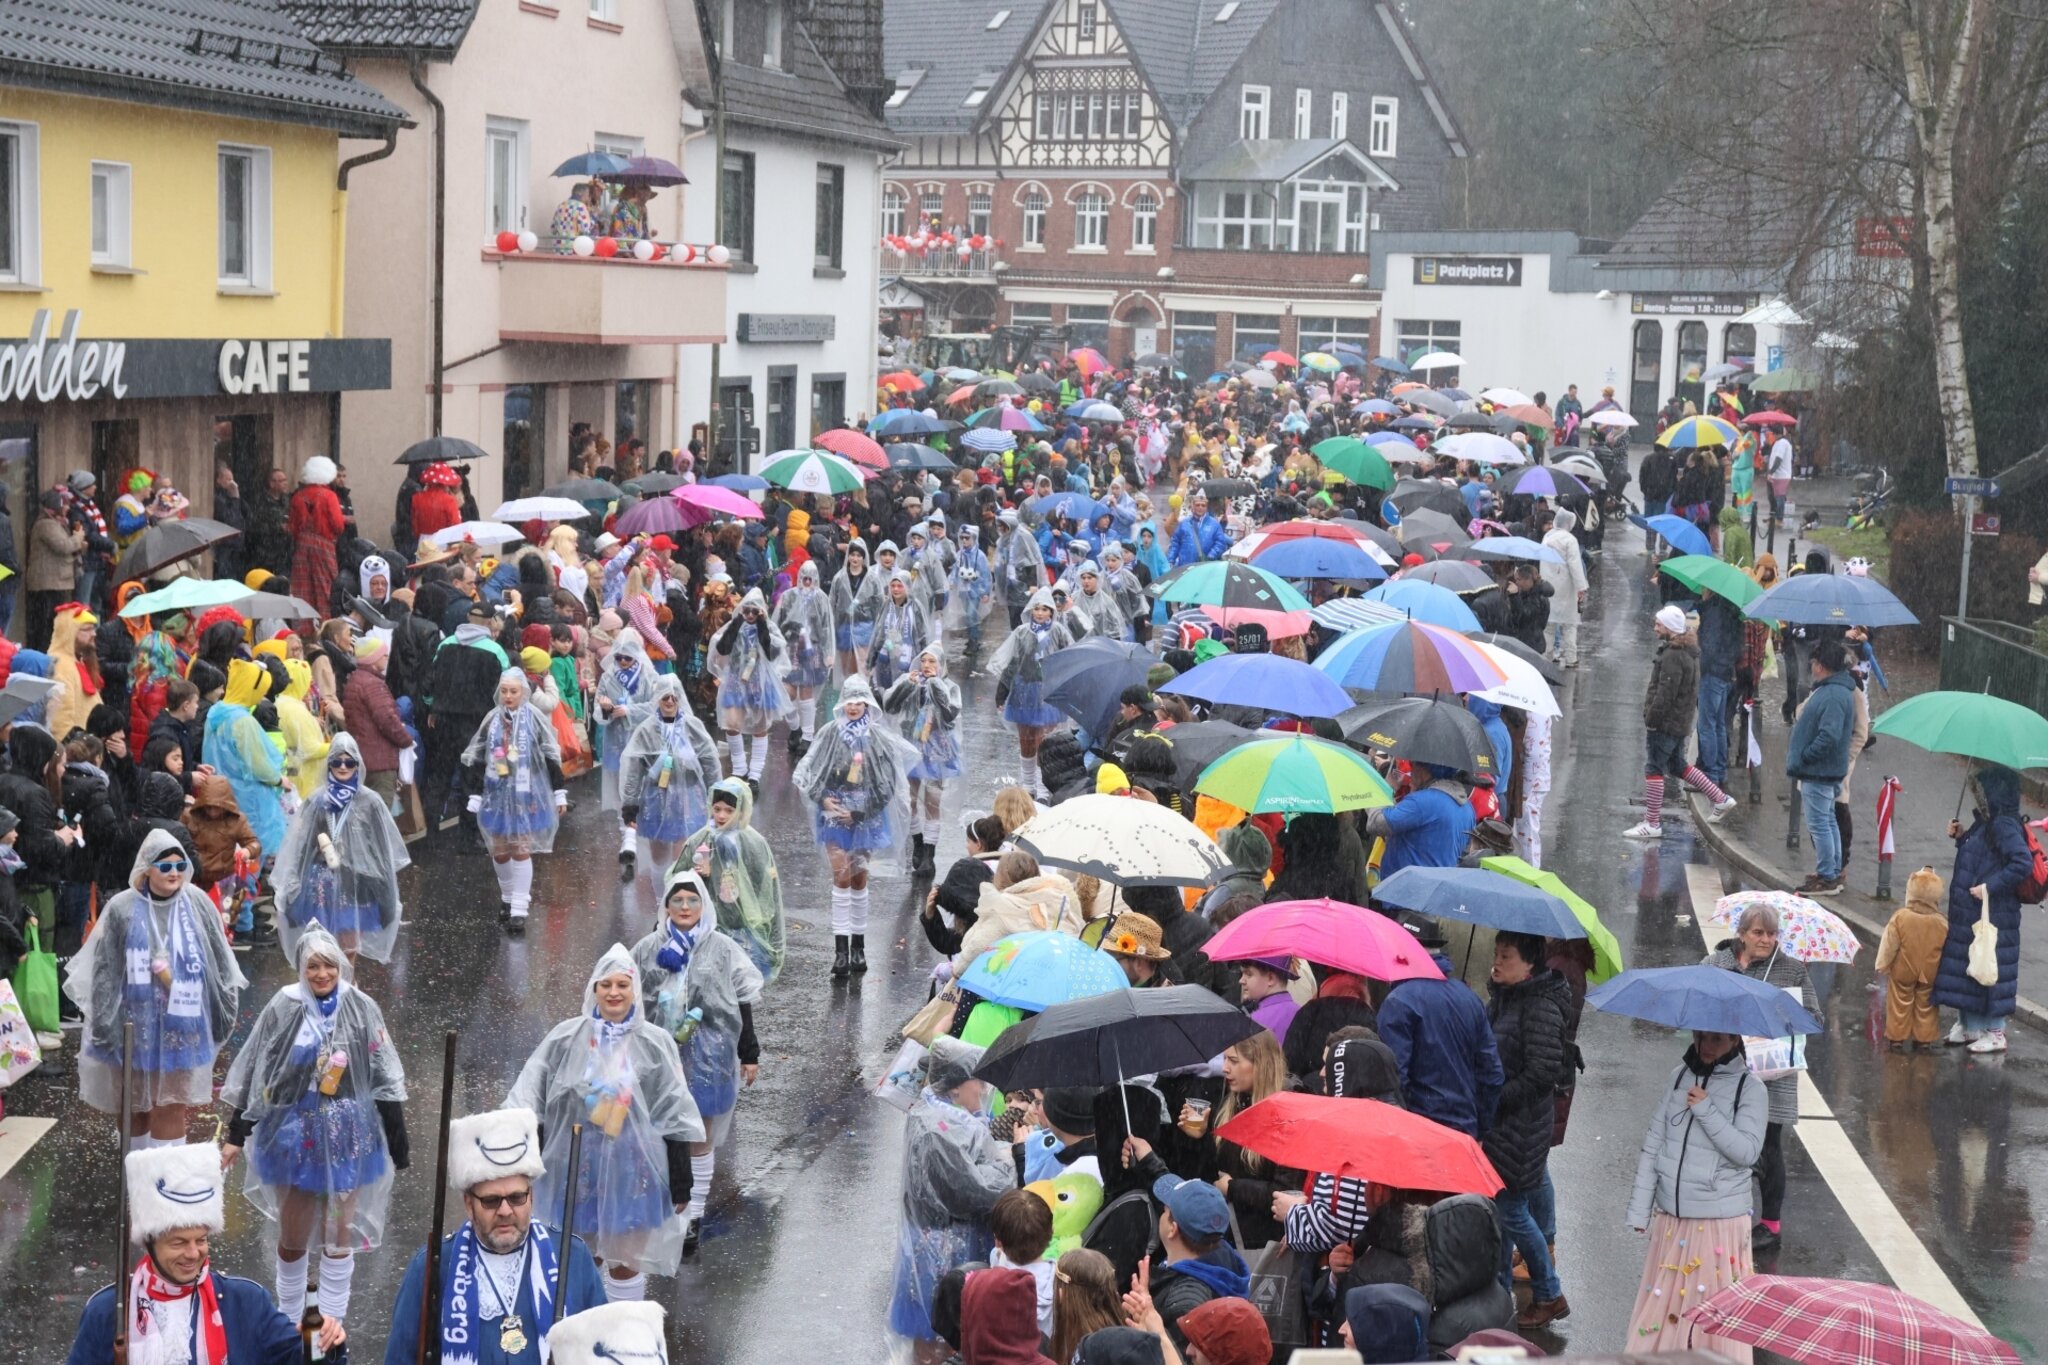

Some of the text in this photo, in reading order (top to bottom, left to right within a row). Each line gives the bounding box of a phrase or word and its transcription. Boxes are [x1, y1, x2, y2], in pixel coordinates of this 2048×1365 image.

[1440, 263, 1504, 280] Parkplatz
[1770, 347, 1780, 364] P
[219, 339, 310, 394] CAFE
[1239, 633, 1261, 645] 25/01
[1333, 1061, 1345, 1098] UNO
